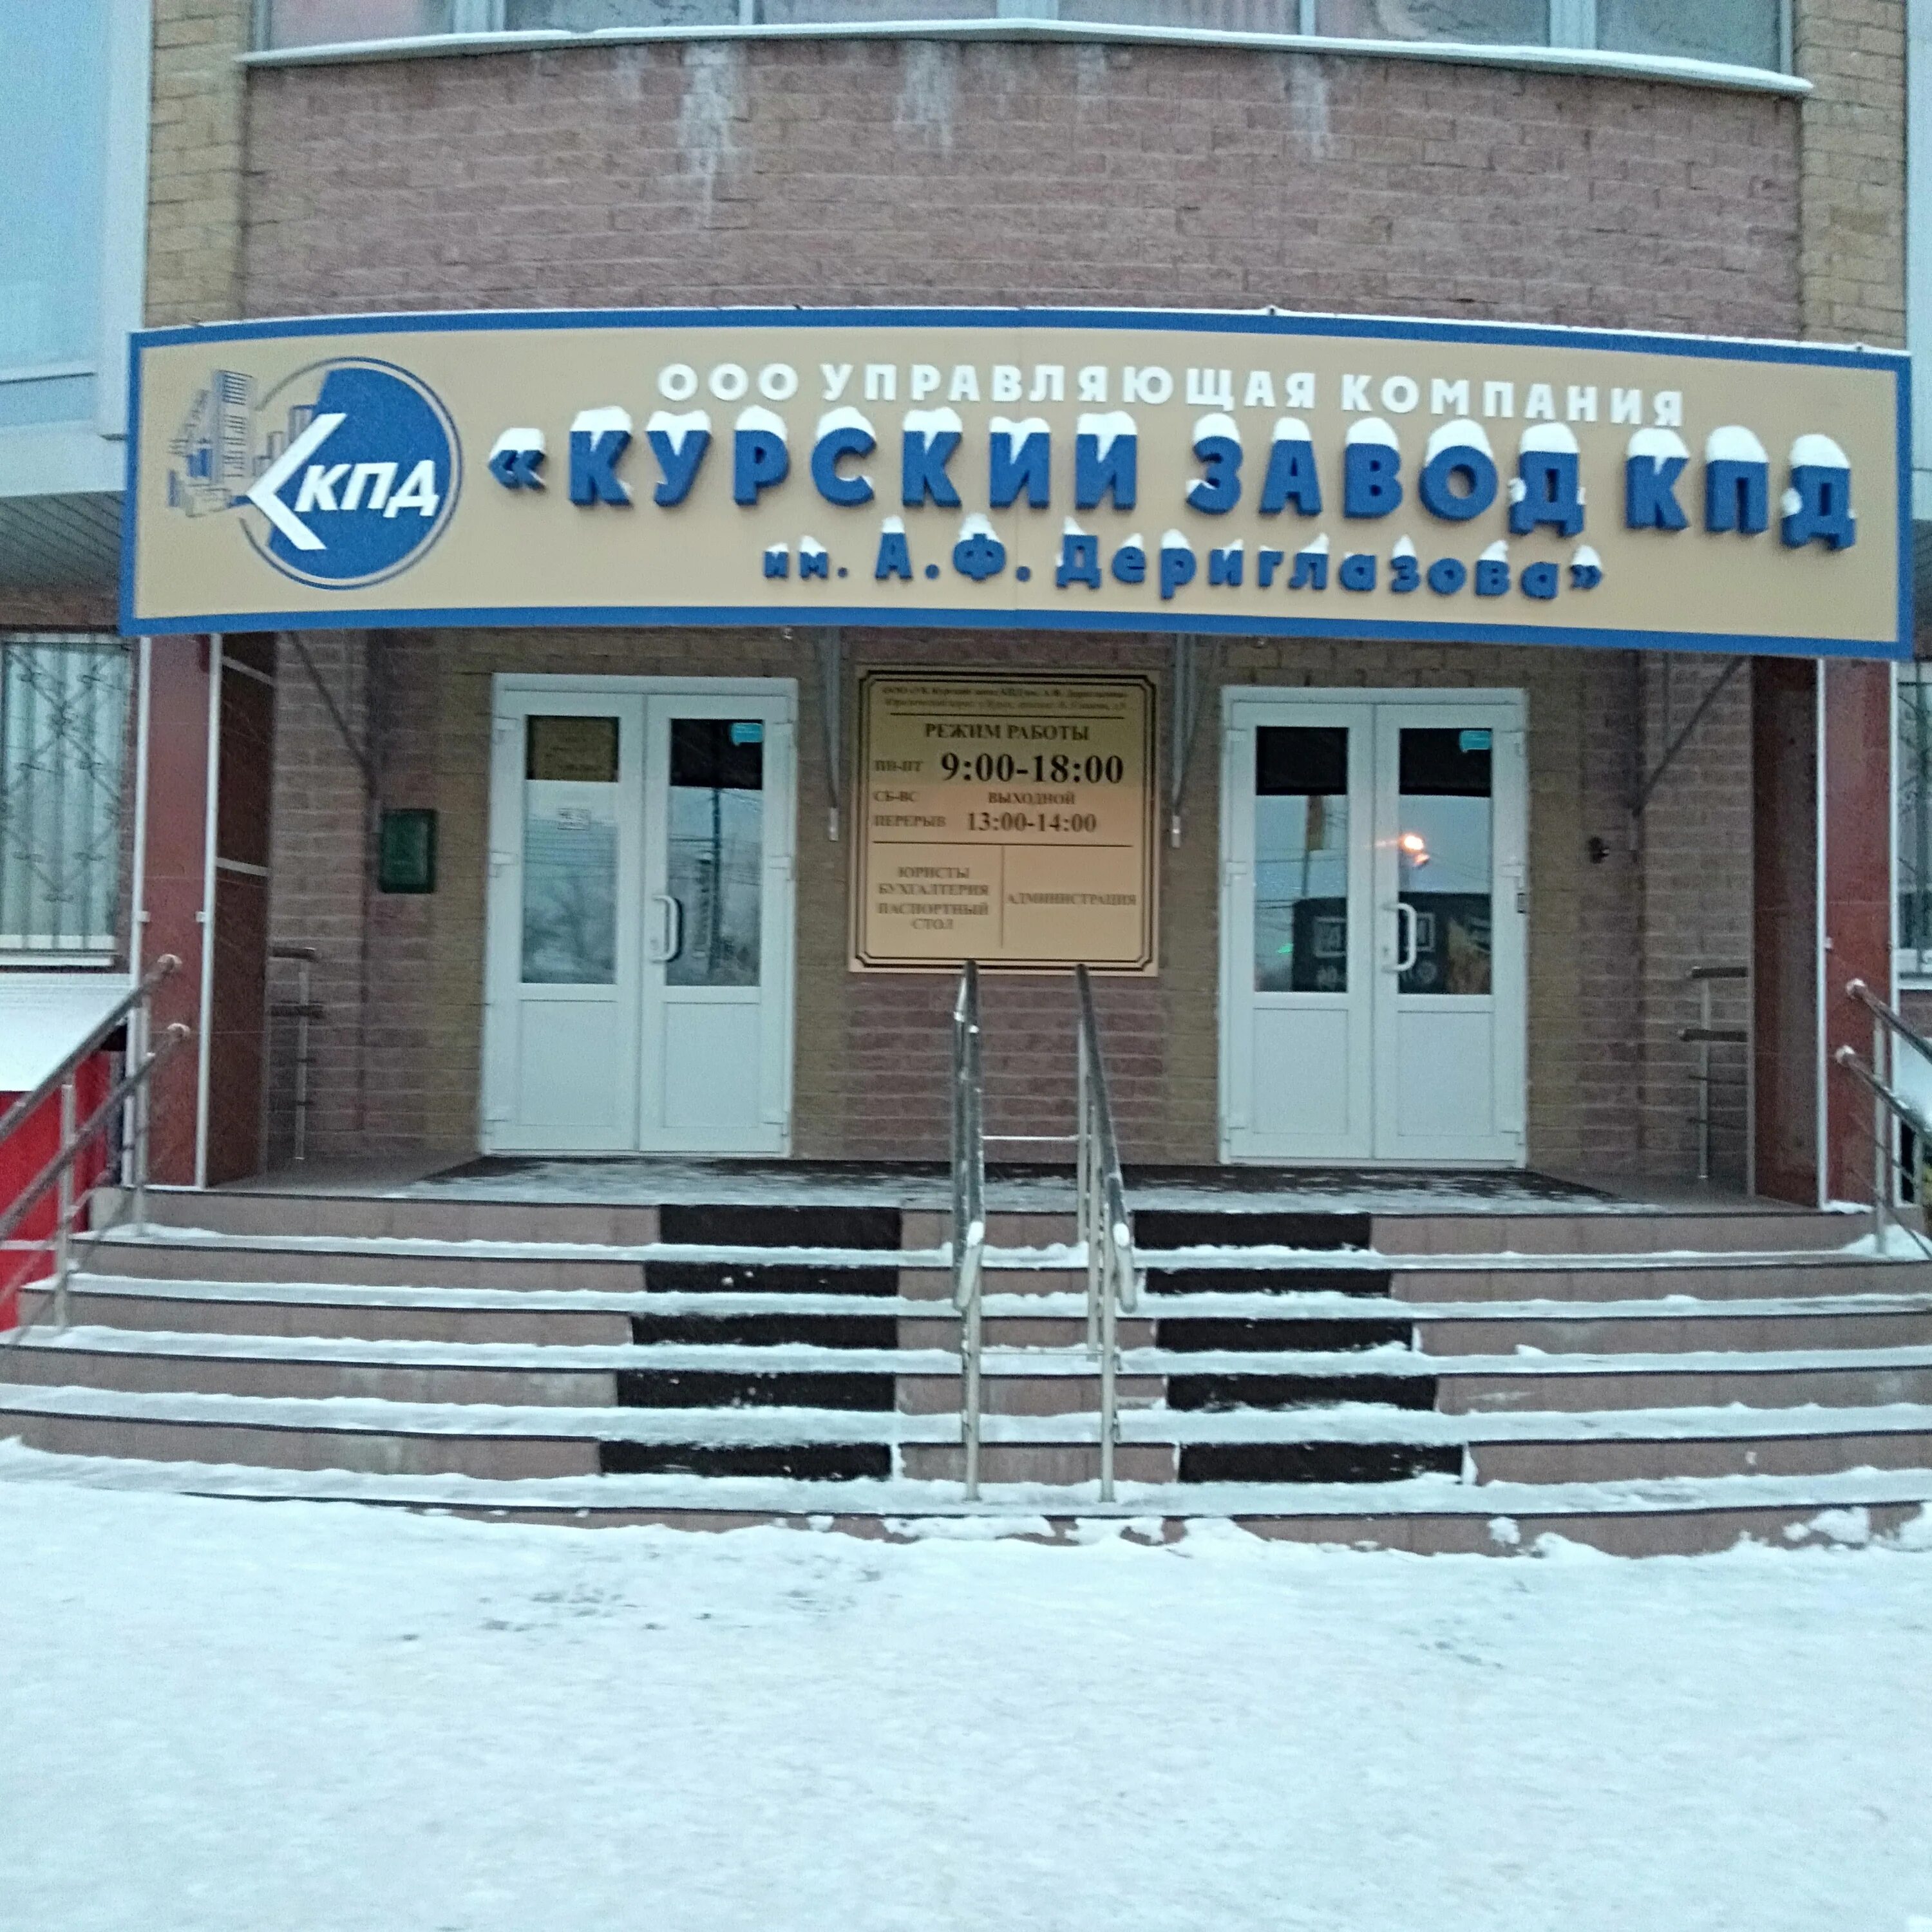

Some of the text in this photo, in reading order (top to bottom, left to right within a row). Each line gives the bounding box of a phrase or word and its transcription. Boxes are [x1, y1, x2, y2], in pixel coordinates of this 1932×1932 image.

[658, 363, 1683, 426] ООО УПРАВЛЯЮЩАЯ КОМПАНИЯ
[294, 460, 440, 518] КПД
[1186, 425, 1585, 536] ЗАВОД
[1625, 444, 1855, 551] КПД
[925, 723, 1090, 741] РЕЖИМ РАБОТЫ
[941, 752, 1124, 784] 9:00-18:00
[873, 790, 1075, 805] СБ-ВС ВЫХОДНОЙ
[875, 811, 1097, 832] ПЕРЕРЫВ 13:00-14:00
[898, 866, 969, 878] ЮРИСТЫ
[878, 883, 990, 896] БУХГАЛТЕРИЯ
[1007, 893, 1137, 905] АДМИНИСТРАЦИЯ
[878, 902, 990, 915] ПАСПОРТНЫЙ
[912, 918, 954, 929] СТОЛ
